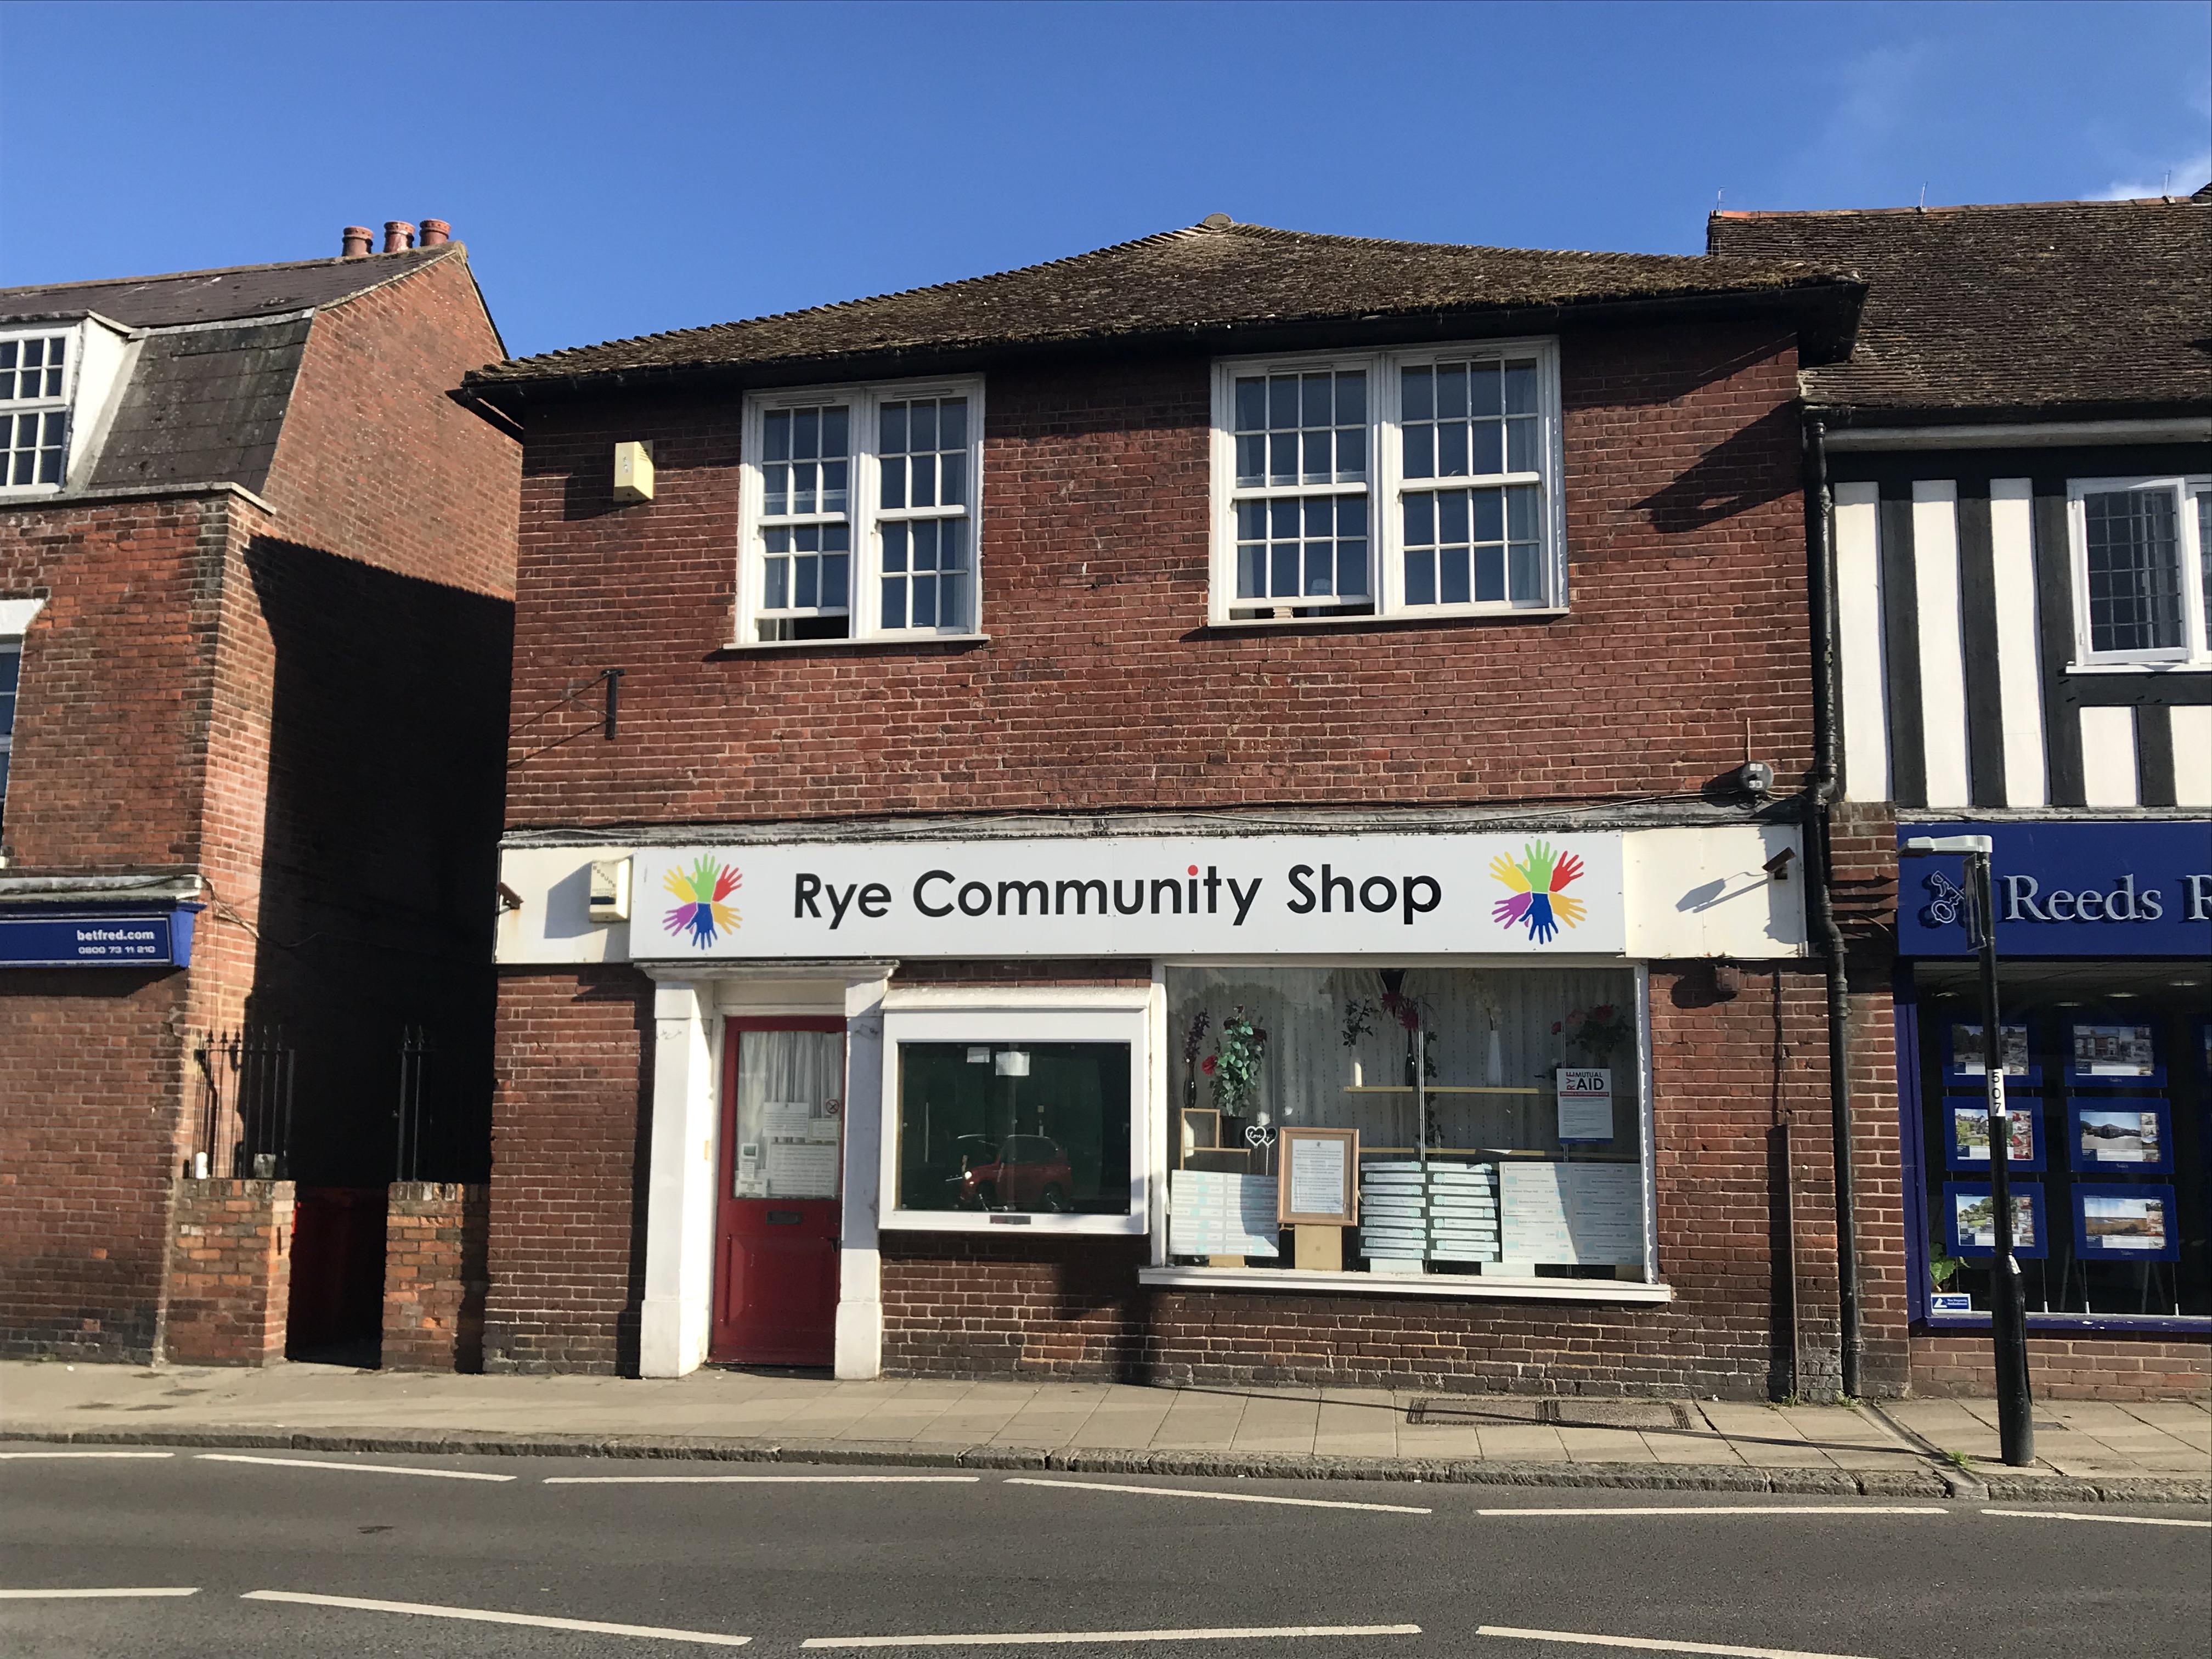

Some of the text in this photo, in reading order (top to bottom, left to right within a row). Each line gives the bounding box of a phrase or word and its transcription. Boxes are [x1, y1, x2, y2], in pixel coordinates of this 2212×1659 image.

[795, 864, 1441, 929] Rye Community Shop
[2004, 874, 2163, 920] Reeds
[77, 929, 154, 940] betfred.com
[78, 946, 106, 954] 0800
[1566, 1071, 1575, 1091] RYE
[1576, 1078, 1604, 1091] AID
